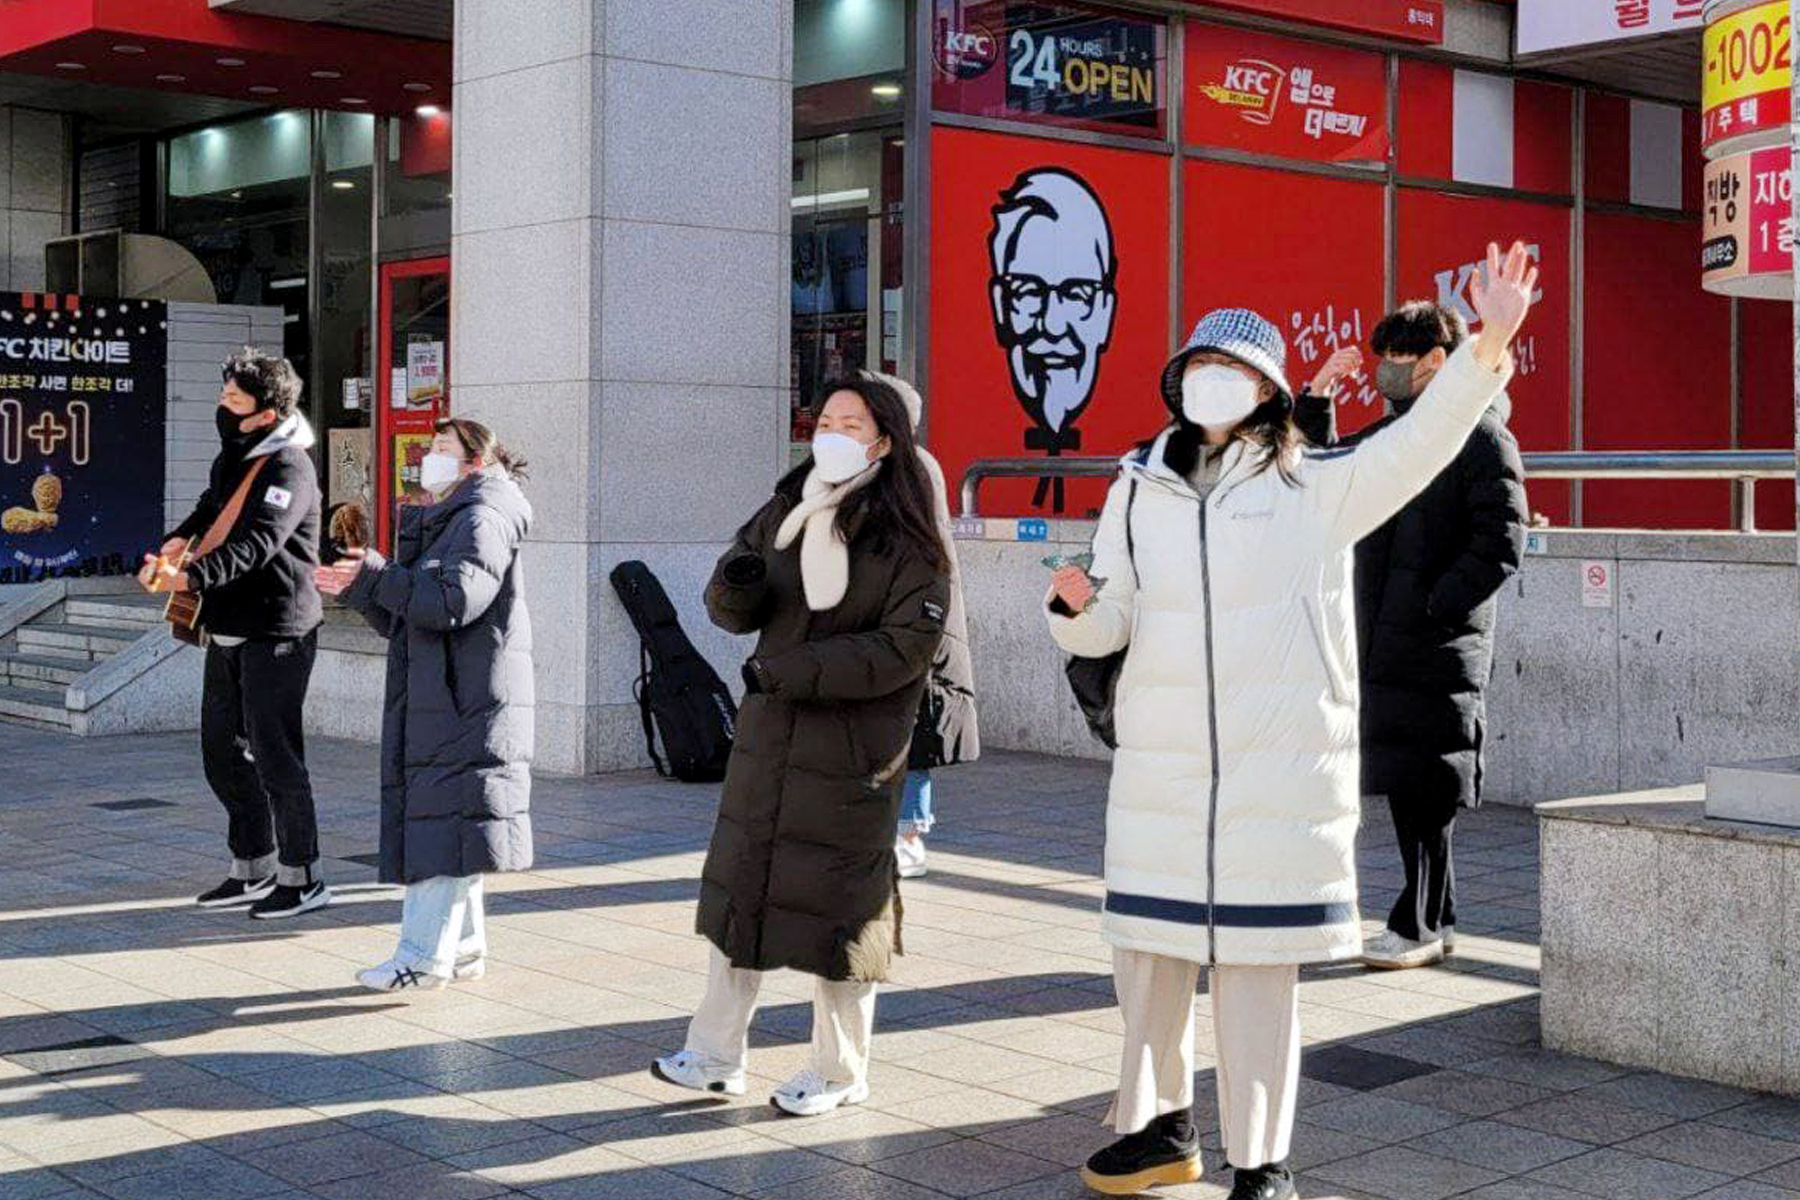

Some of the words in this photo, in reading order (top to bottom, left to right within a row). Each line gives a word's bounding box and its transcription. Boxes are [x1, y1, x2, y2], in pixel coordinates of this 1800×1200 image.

[946, 31, 989, 55] KFC
[1010, 29, 1060, 90] 24
[1059, 36, 1102, 57] HOURS
[1064, 58, 1152, 103] OPEN
[1224, 65, 1272, 96] KFC
[0, 399, 91, 466] 1+1
